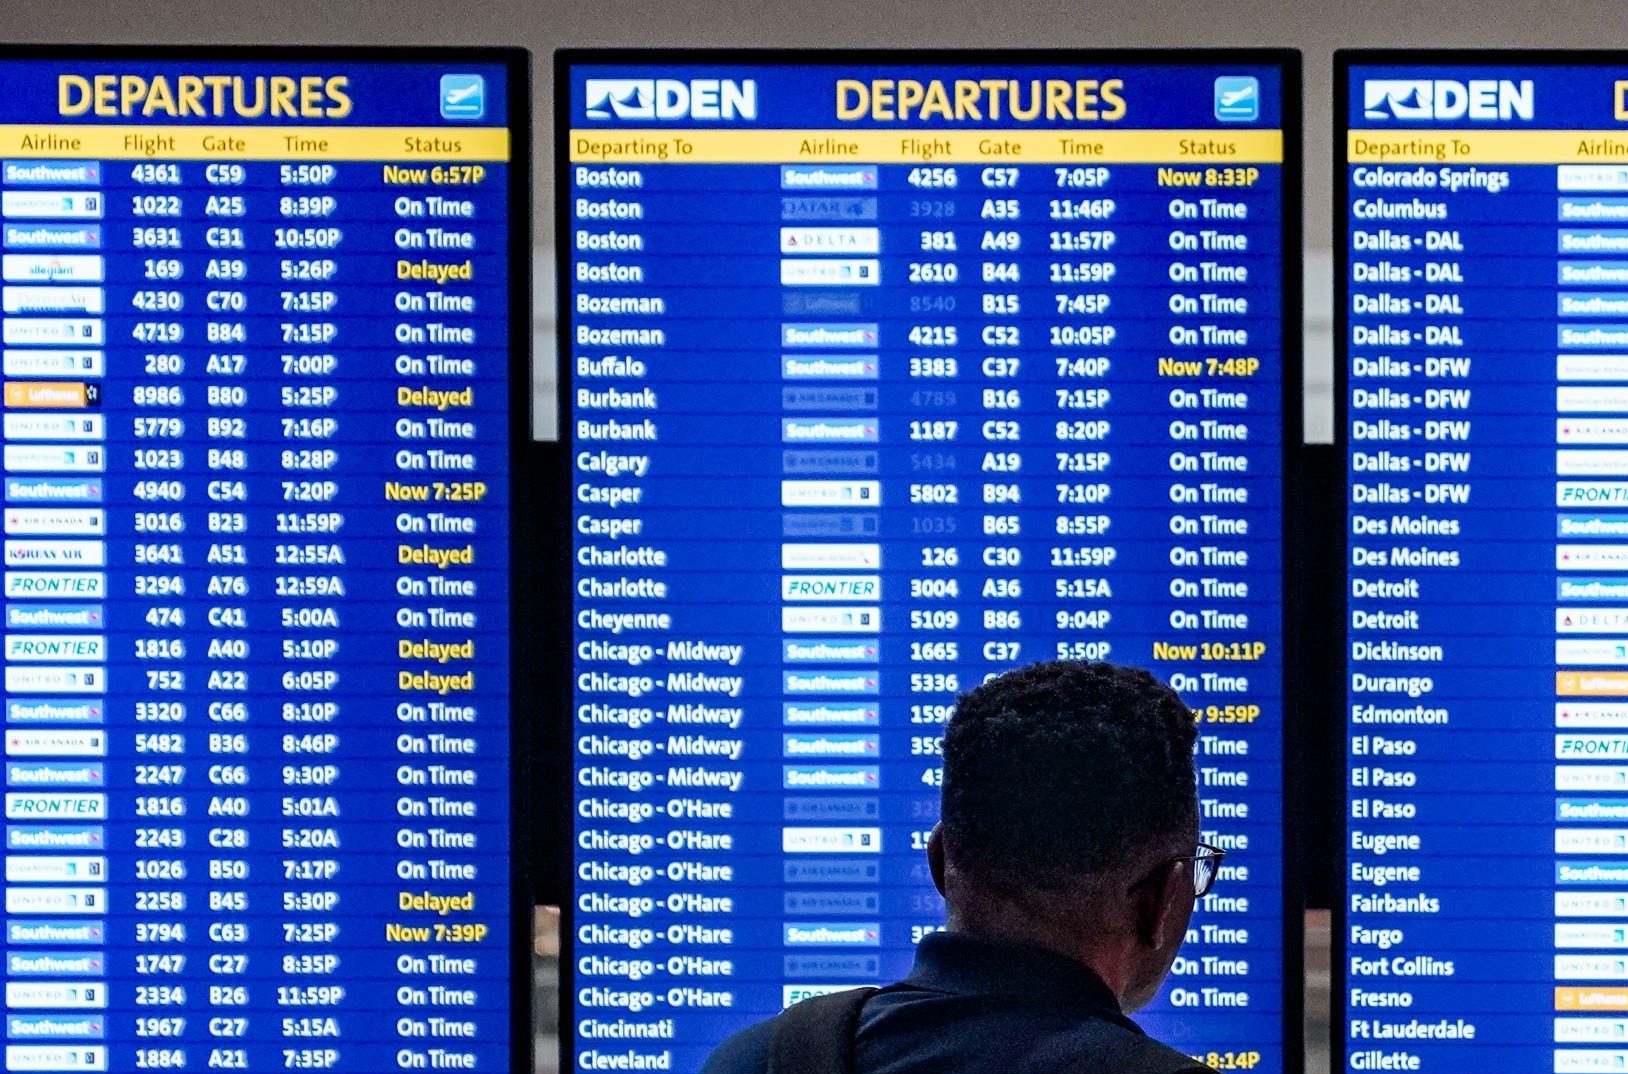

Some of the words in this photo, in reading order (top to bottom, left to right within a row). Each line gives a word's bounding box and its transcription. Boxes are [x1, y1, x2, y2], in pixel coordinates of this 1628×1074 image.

[59, 75, 351, 117] DEPARTURES
[657, 80, 755, 118] DEN
[837, 80, 1126, 120] DEPARTURES
[1435, 80, 1533, 119] DEN
[21, 134, 80, 150] Airline
[125, 134, 174, 155] Flight
[203, 136, 245, 151] Gate
[284, 136, 328, 152] Time
[405, 137, 462, 152] Status
[577, 139, 668, 158] Departing
[674, 139, 692, 154] To
[800, 138, 858, 154] Airline
[902, 139, 951, 158] Flight
[979, 140, 1021, 155] Gate
[1060, 139, 1103, 155] Time
[1179, 139, 1236, 155] Status
[1355, 139, 1446, 158] Departing
[1452, 140, 1470, 155] To
[6, 167, 87, 183] Southwest
[132, 165, 179, 182] 4361
[206, 164, 242, 182] C59
[281, 165, 333, 183] 5:50P
[384, 166, 427, 183] Now
[431, 166, 483, 184] 6:57P
[576, 168, 641, 185] Boston
[784, 168, 866, 187] Southwest
[908, 169, 956, 186] 4256
[982, 168, 1018, 186] C57
[1055, 168, 1108, 186] 7:05P
[1158, 168, 1202, 186] Now
[1206, 168, 1258, 186] 8:33P
[1353, 199, 1446, 218] Columbus
[135, 545, 181, 563] 3641
[208, 545, 245, 563] A51
[276, 545, 342, 563] 12:55A
[399, 544, 473, 568] Delayed
[578, 578, 665, 597] Charlotte
[788, 580, 876, 597] FRONTIER
[911, 580, 958, 597] 3004
[983, 579, 1020, 596] A36
[1056, 579, 1110, 597] 5:15A
[1170, 579, 1197, 596] On
[1201, 579, 1247, 596] Time
[1353, 736, 1368, 754] El
[1373, 737, 1415, 754] Paso
